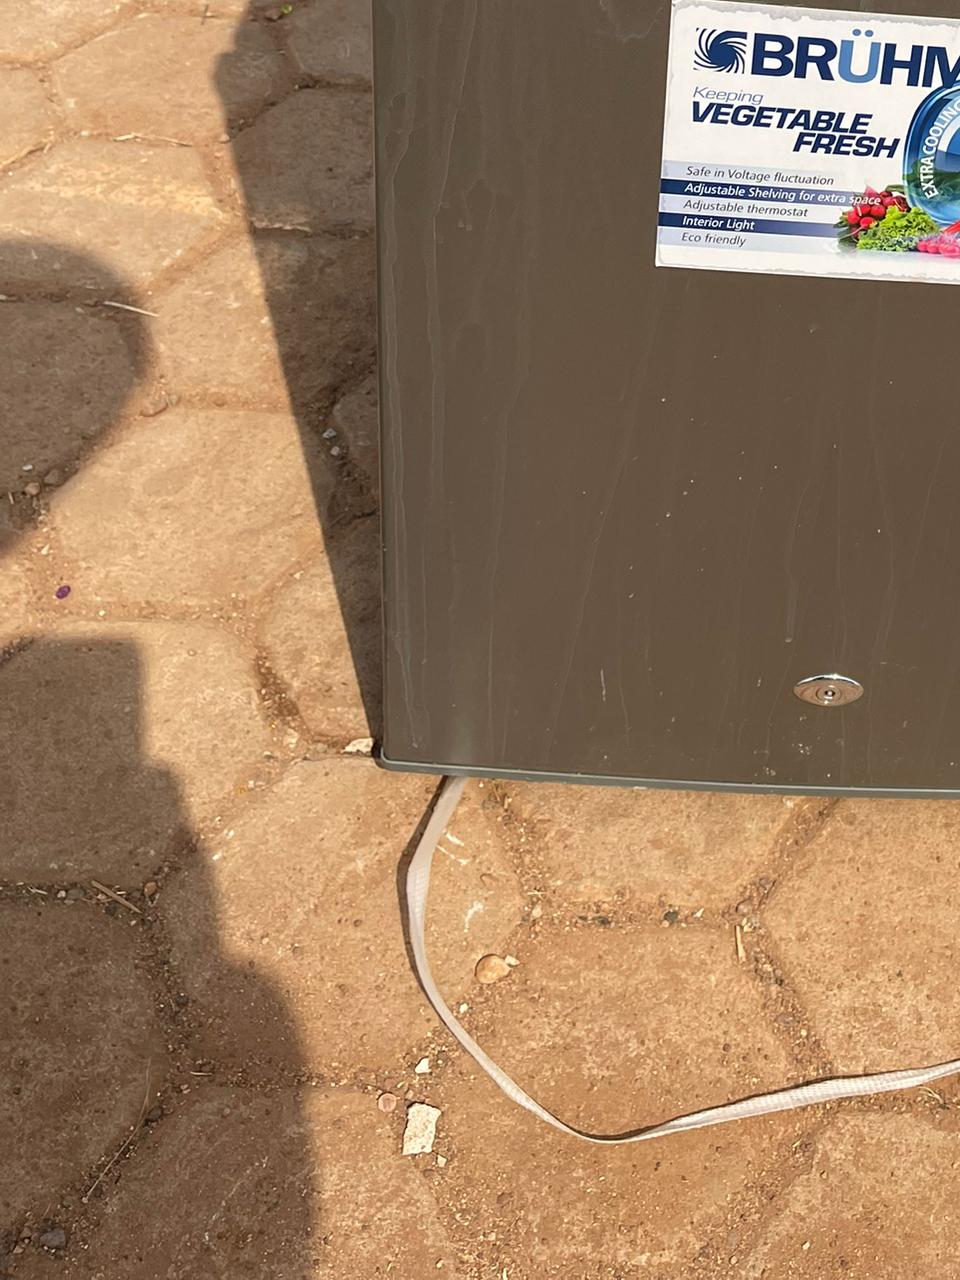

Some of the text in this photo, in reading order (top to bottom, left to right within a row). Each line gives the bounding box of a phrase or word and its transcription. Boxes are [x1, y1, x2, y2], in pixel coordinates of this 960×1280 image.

[692, 86, 764, 105] Keeping
[692, 101, 873, 135] VEGETABLE
[793, 132, 901, 159] FRESH
[686, 166, 834, 186] Safe in Voltage fluctuation
[919, 155, 939, 199] EXTRA
[684, 183, 881, 207] Adjustable Shelving for extra space
[683, 199, 808, 217] Adjustable thermostat
[682, 216, 755, 232] Interior Light
[681, 232, 747, 248] Eco friendly
